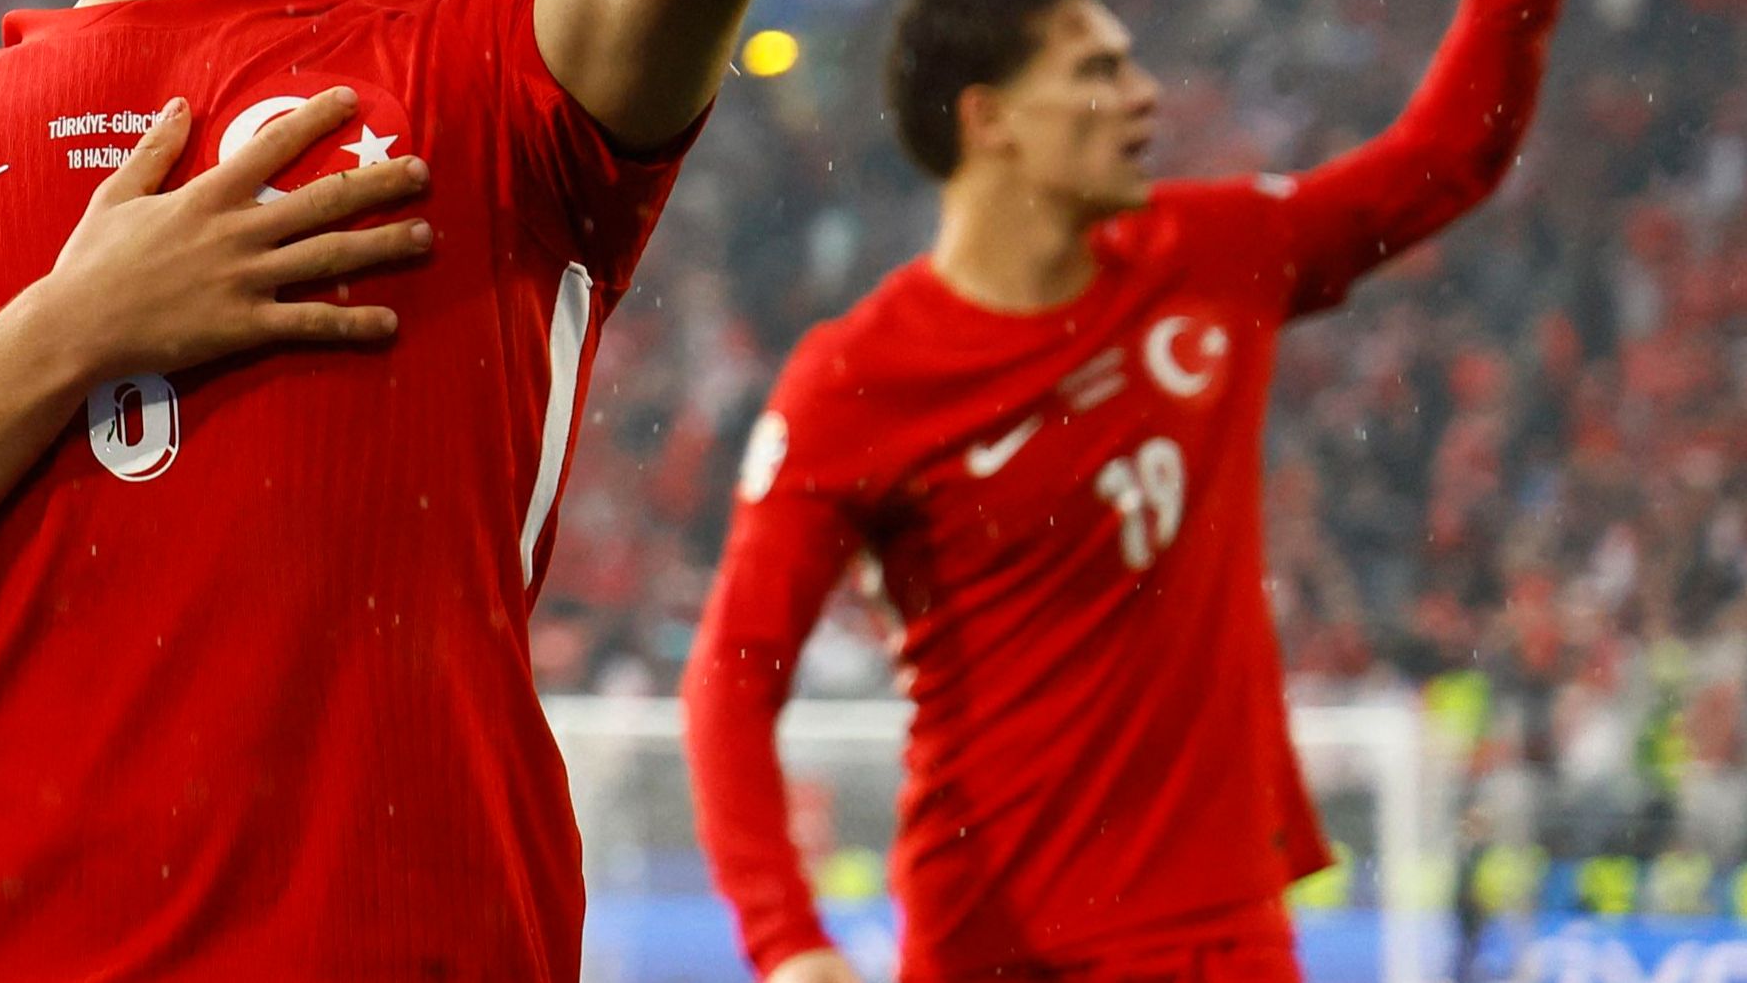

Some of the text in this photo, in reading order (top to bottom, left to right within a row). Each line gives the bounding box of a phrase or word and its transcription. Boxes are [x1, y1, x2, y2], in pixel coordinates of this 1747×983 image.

[67, 144, 135, 169] 18 HAZİRA
[1095, 436, 1186, 571] 19
